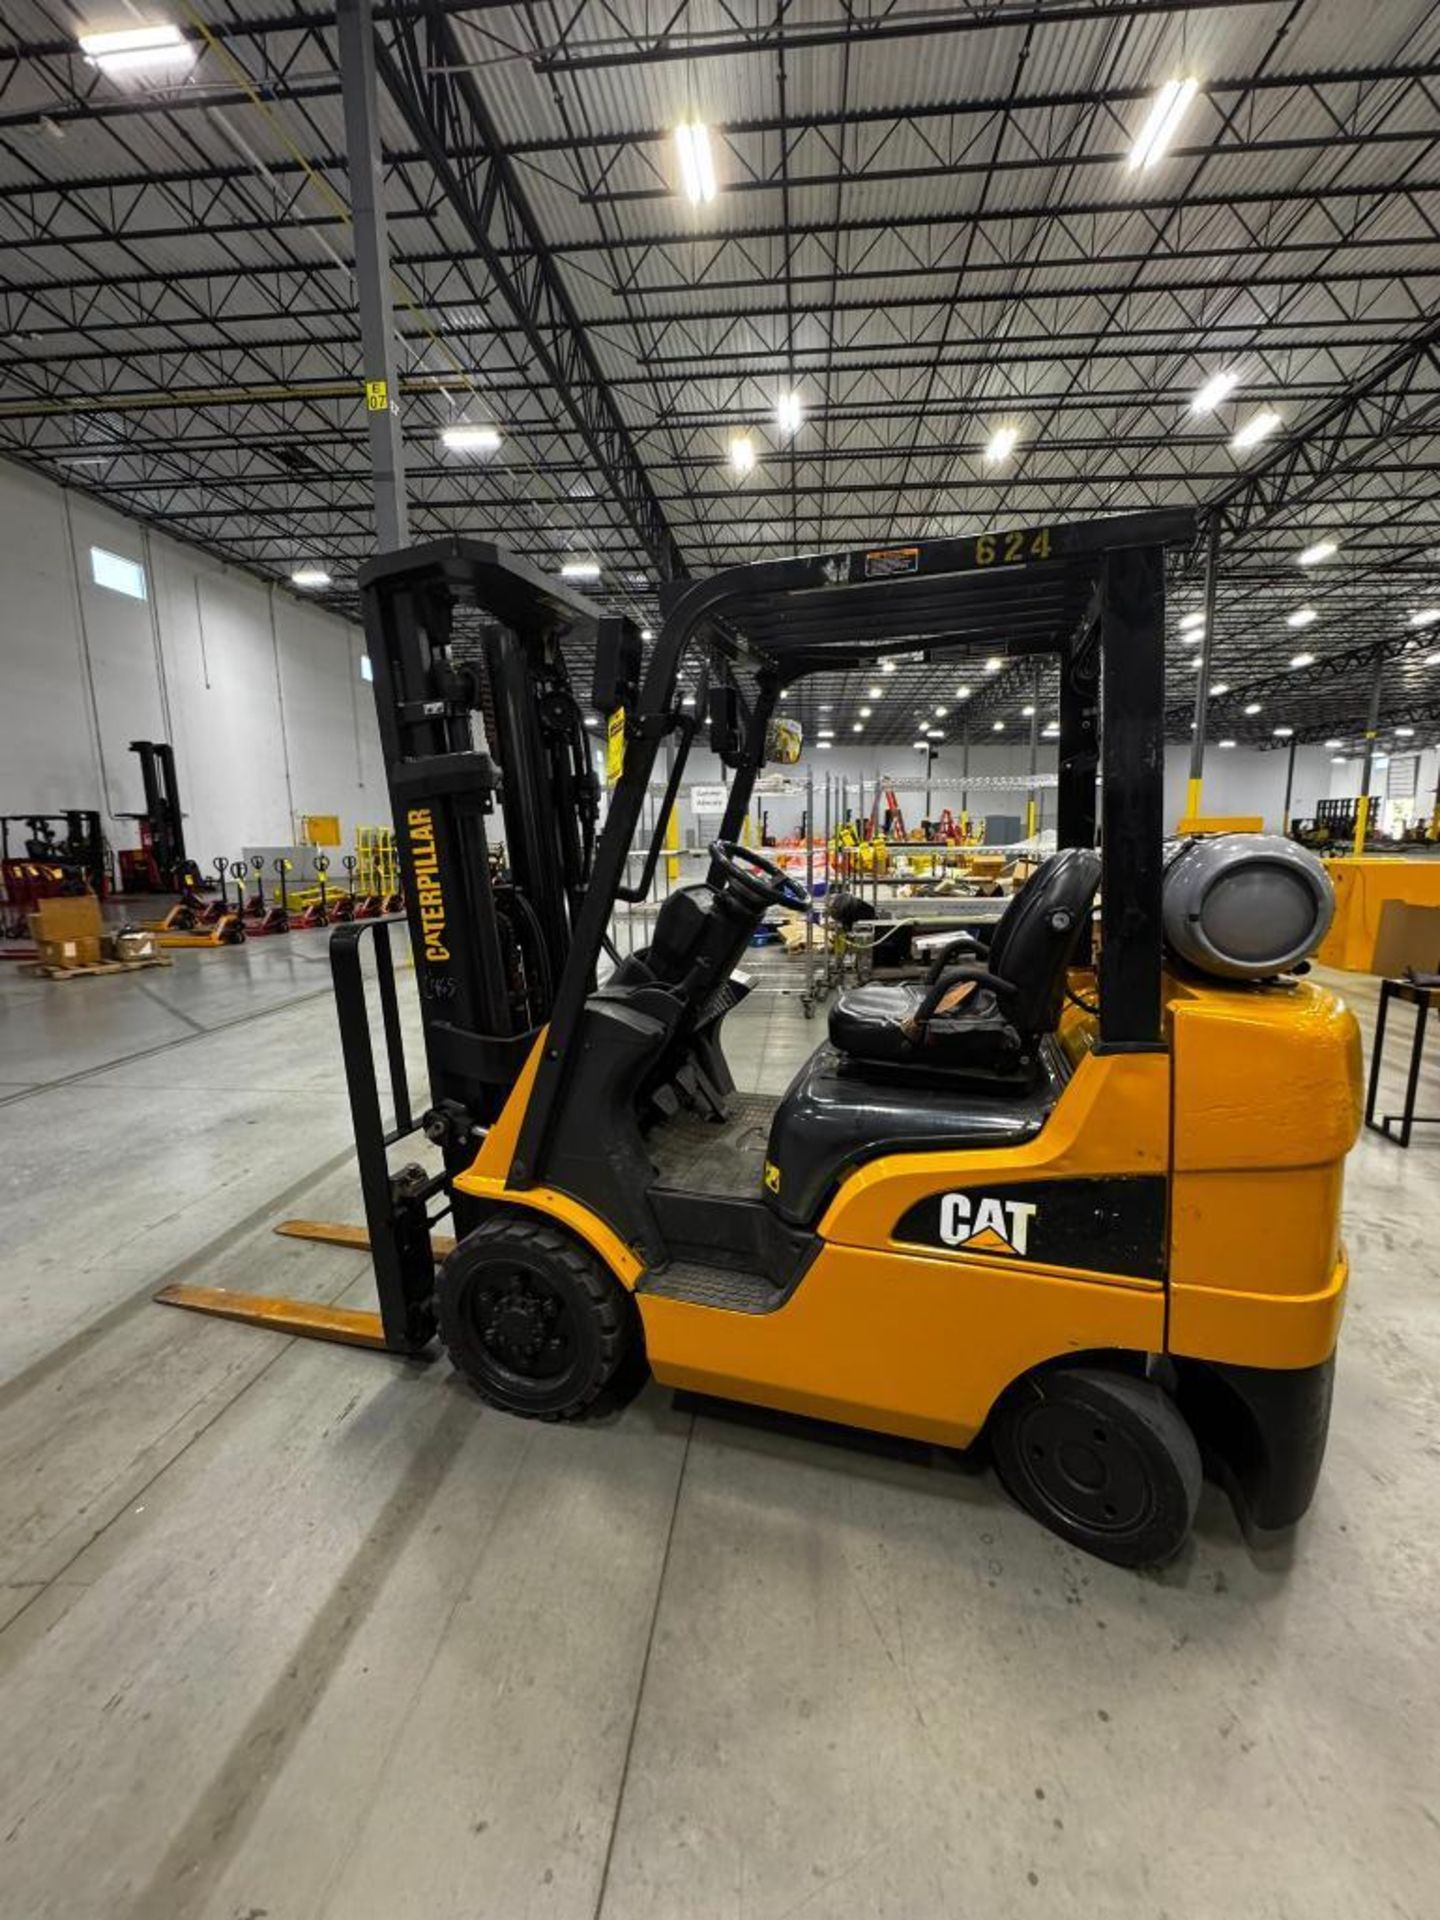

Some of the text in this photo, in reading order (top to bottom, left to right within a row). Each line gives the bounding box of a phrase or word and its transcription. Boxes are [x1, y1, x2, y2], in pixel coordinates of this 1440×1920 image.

[370, 395, 385, 409] 07
[976, 528, 1052, 566] 624
[407, 808, 450, 962] CATERPILLAR
[939, 1192, 1037, 1255] CAT
